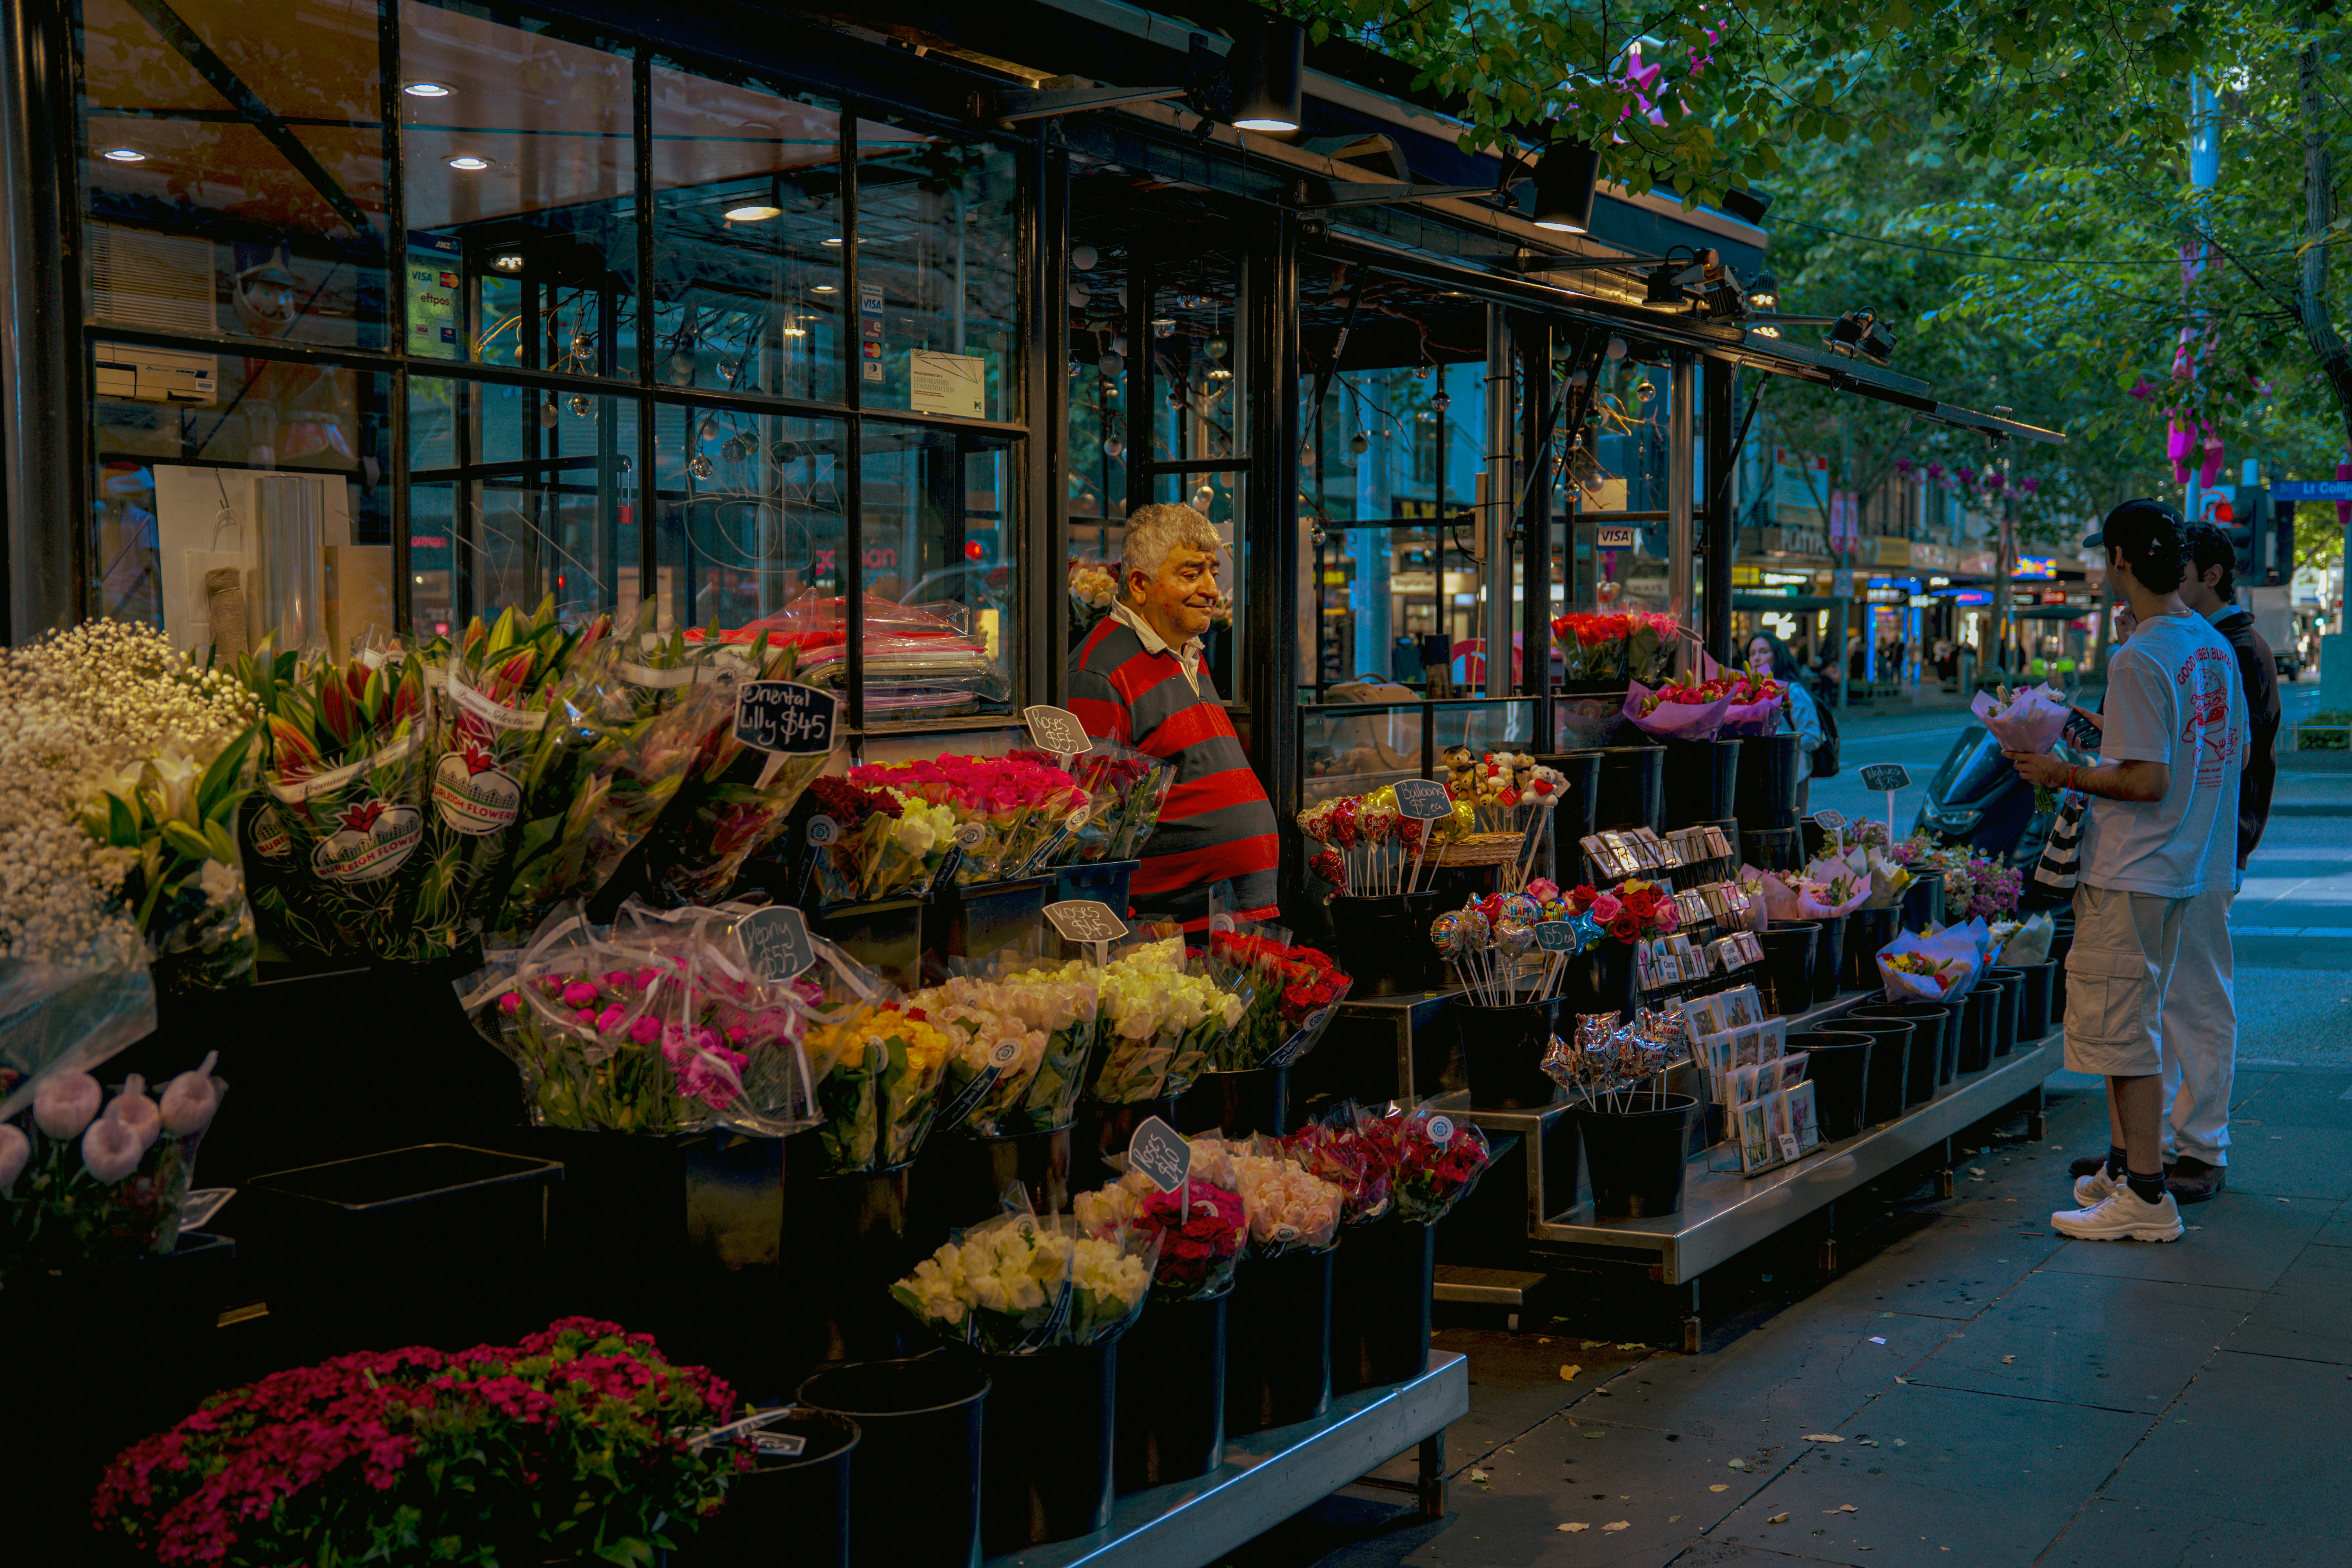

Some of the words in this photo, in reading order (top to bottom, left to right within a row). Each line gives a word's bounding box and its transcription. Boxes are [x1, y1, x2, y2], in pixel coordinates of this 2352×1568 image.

[436, 240, 451, 250] ANZ
[412, 271, 432, 282] VISA
[421, 293, 450, 306] eftpos
[864, 298, 881, 310] VISA
[913, 383, 955, 394] COMMENDATION
[928, 377, 949, 386] MAYOR'S
[2303, 482, 2316, 494] Lt
[1602, 530, 1629, 541] VISA
[2178, 655, 2196, 685] GOOD
[2194, 647, 2210, 663] VIBES
[456, 690, 488, 714] Premium
[488, 706, 534, 727] Selection
[740, 704, 777, 746] Lilly
[780, 705, 826, 745] $45
[1032, 708, 1069, 732] Roses
[1045, 729, 1079, 753] $55
[299, 775, 350, 797] Premium
[1401, 782, 1445, 799] Balloons
[431, 785, 463, 809] BURLEIGH
[466, 804, 516, 820] FLOWERS
[1410, 798, 1430, 817] $5
[1430, 802, 1444, 812] ea
[1313, 817, 1329, 832] Love
[1368, 816, 1385, 826] Love
[1044, 837, 1058, 851] Valley
[318, 852, 375, 876] BURLEIGH
[945, 852, 958, 869] Valley
[1053, 905, 1100, 920] Roses
[1071, 918, 1112, 940] $45
[1541, 924, 1563, 950] $5
[1564, 934, 1574, 944] ea
[1722, 947, 1735, 956] Cards
[757, 942, 799, 979] $55
[1727, 956, 1739, 965] $4.50
[1662, 1026, 1680, 1036] MERRY
[1283, 1039, 1299, 1053] Valley
[1781, 1136, 1794, 1145] Cards
[1132, 1133, 1166, 1169] Roses
[1786, 1148, 1793, 1156] $5
[1154, 1147, 1183, 1184] $40
